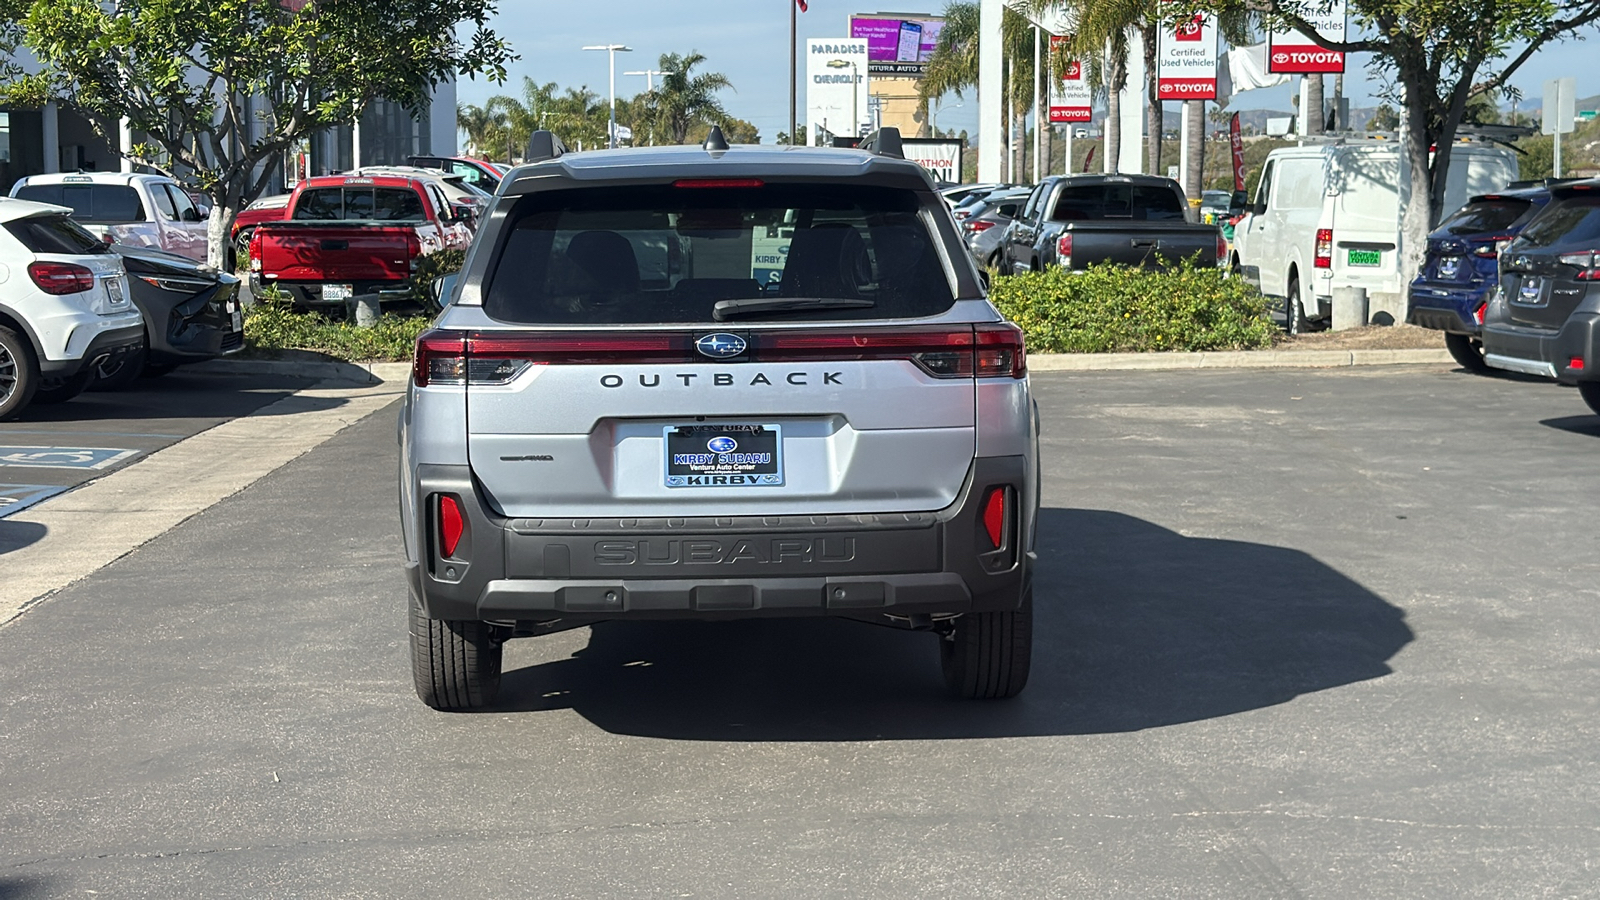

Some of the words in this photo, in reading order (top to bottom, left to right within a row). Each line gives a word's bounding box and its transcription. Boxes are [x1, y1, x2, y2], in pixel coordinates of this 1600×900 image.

[811, 44, 865, 54] PARADISE
[1170, 48, 1206, 57] Certified
[1290, 53, 1342, 63] TOYOTA
[1160, 59, 1181, 67] Used
[1182, 59, 1215, 67] Vehicles
[868, 65, 895, 73] NTURA
[1174, 84, 1214, 92] TOYOTA
[1061, 110, 1090, 118] TOYOTA
[755, 255, 781, 264] KIRBY
[599, 372, 843, 389] OUTBACK
[674, 453, 715, 465] KIRBY
[718, 453, 771, 464] SUBARU
[687, 475, 761, 485] KIRBY
[594, 537, 856, 566] SUBARU
